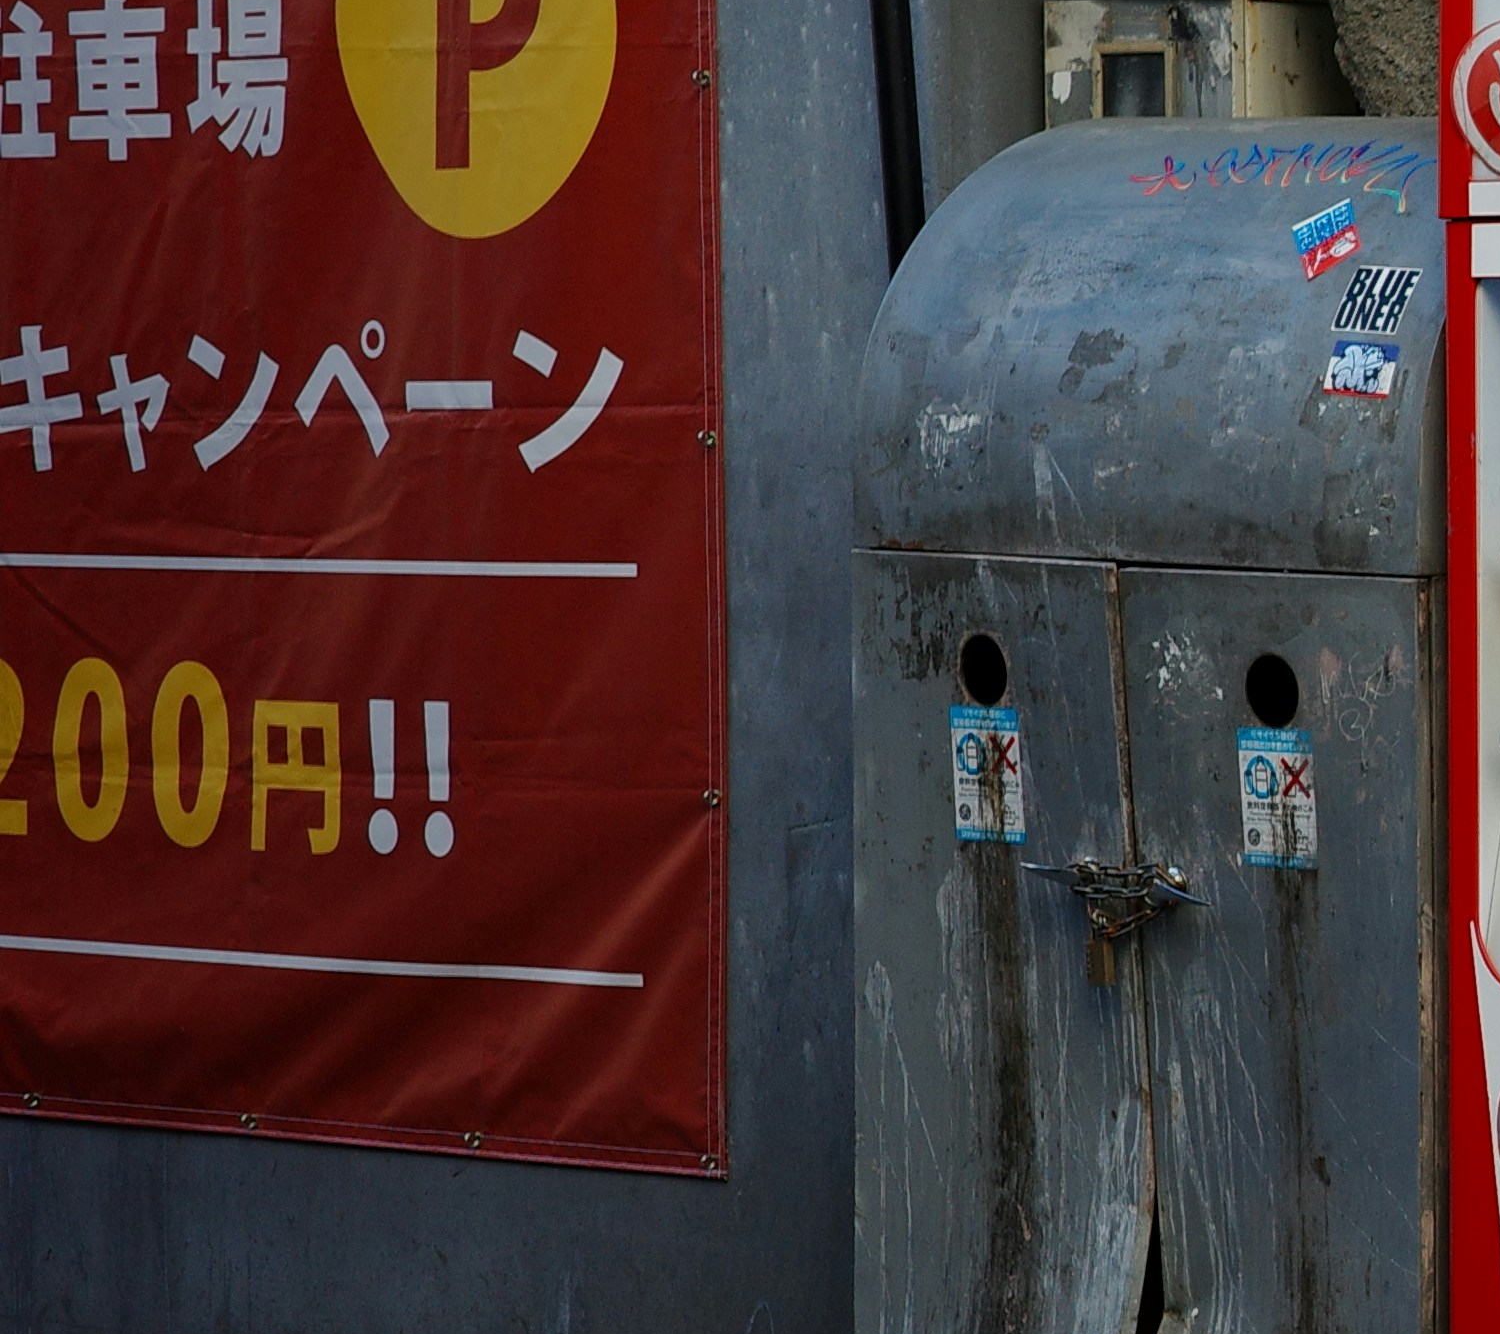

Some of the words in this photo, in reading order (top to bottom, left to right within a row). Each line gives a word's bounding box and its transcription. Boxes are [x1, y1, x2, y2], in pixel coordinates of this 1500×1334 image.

[0, 320, 624, 473] キャンペーン
